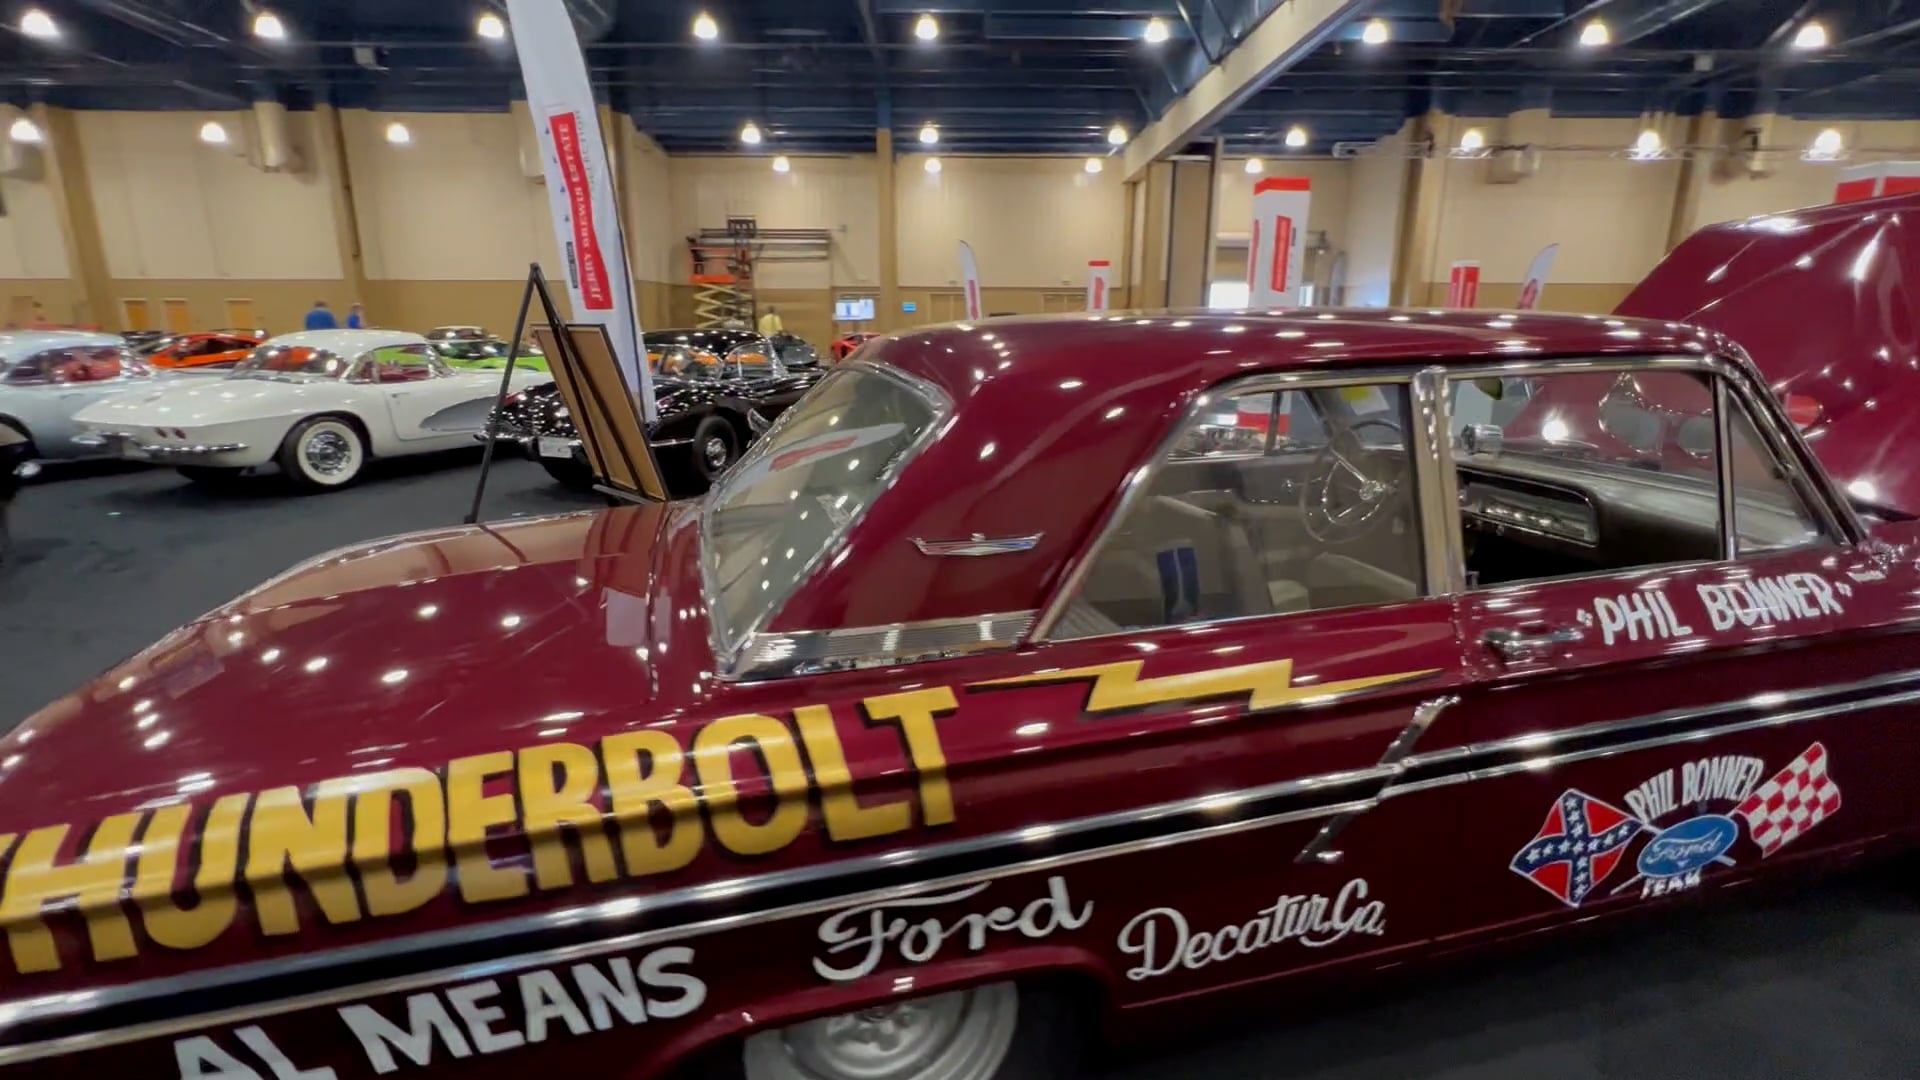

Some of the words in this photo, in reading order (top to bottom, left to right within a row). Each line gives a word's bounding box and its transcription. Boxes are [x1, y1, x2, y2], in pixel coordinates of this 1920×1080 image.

[558, 123, 580, 182] ESTATE
[584, 253, 604, 302] JERRY
[1623, 767, 1679, 825] PHIL
[1681, 754, 1765, 807] BONNER
[0, 685, 960, 975] HUNDERBOLT
[1645, 826, 1724, 866] Ford
[812, 875, 1095, 981] Ford
[173, 1025, 339, 1080] AL
[338, 946, 707, 1075] MEANS
